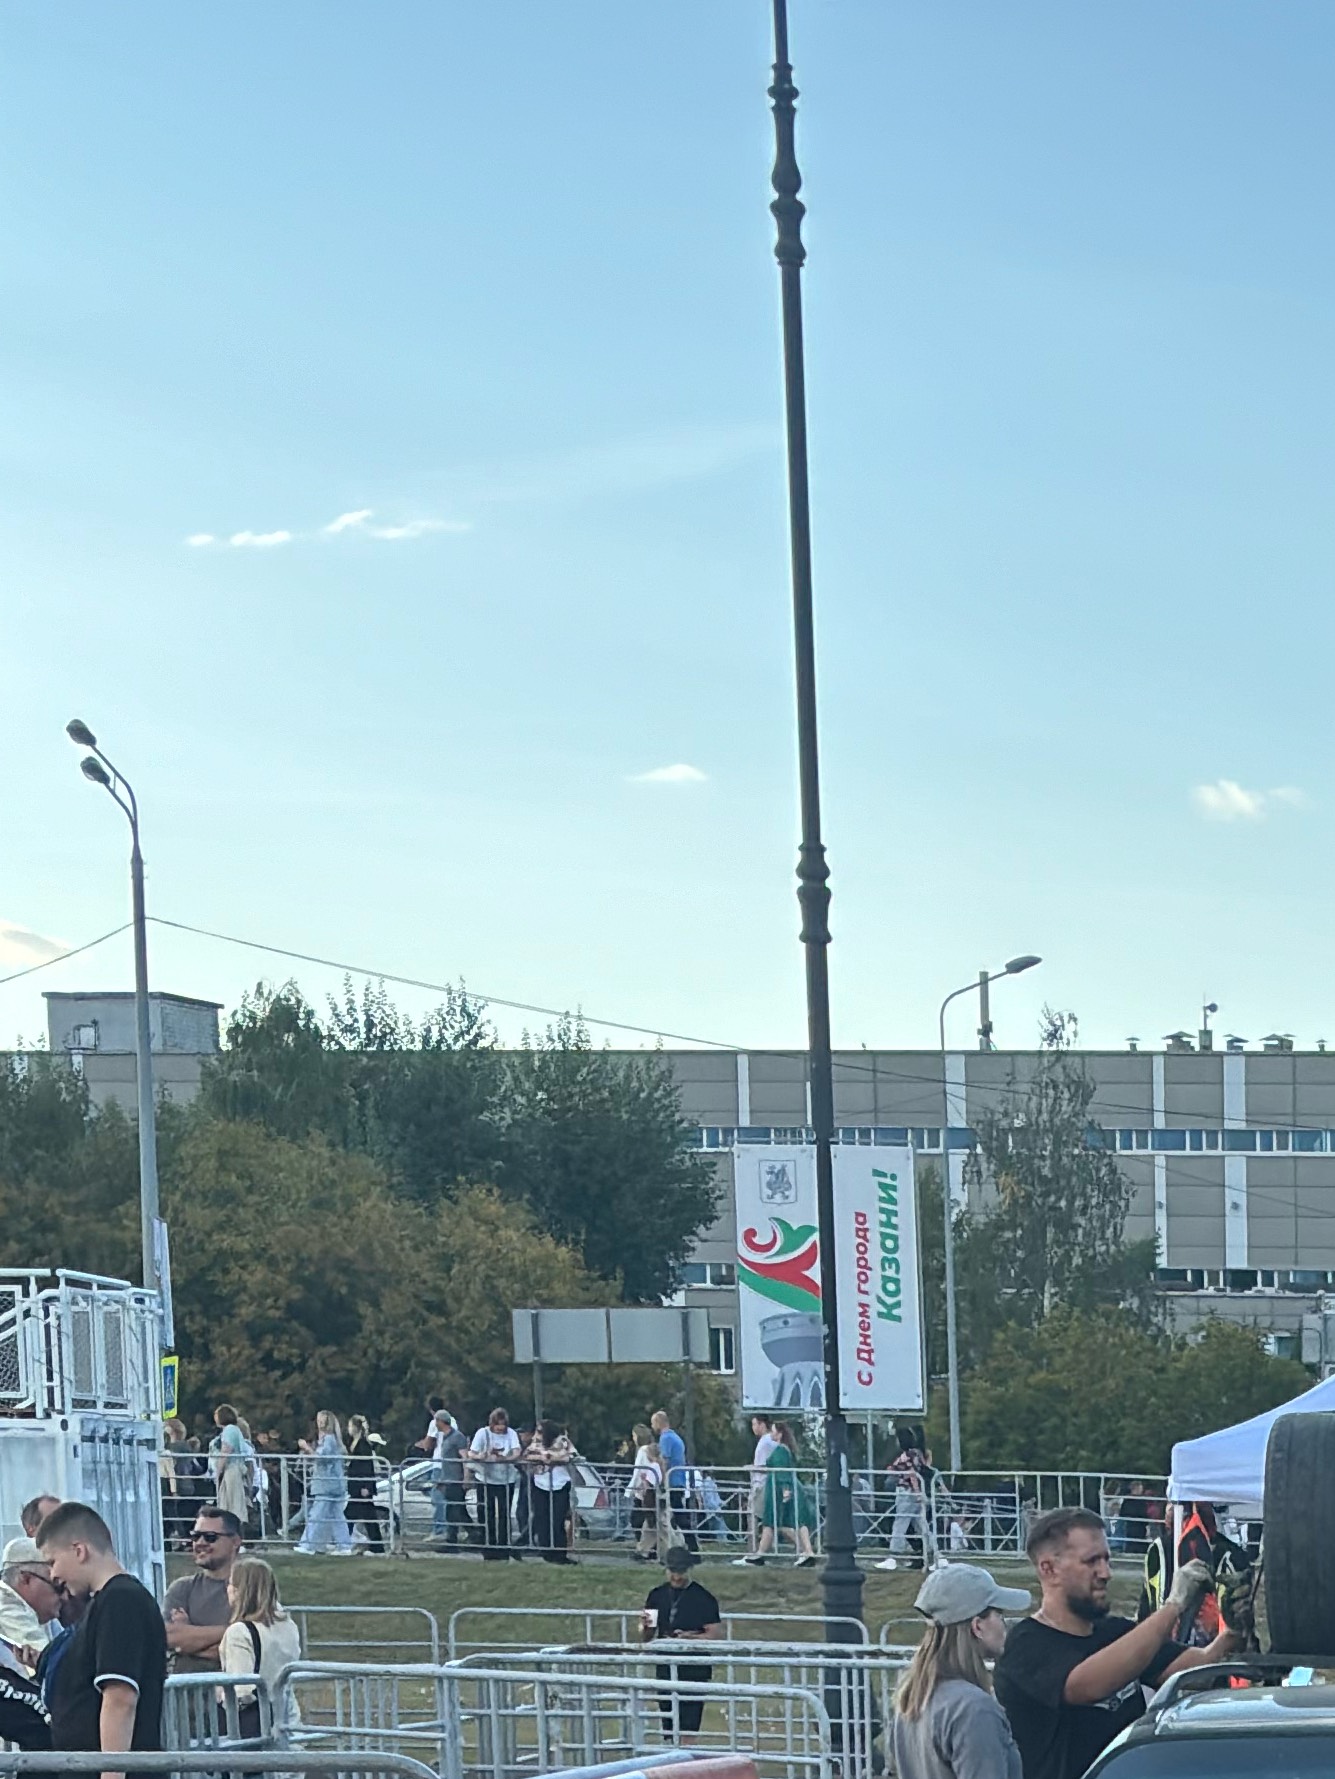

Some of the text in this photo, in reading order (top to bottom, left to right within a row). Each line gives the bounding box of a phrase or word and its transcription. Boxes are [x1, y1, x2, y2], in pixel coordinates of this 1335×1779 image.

[854, 1211, 875, 1387] С Днем города
[872, 1168, 902, 1323] Казани!
